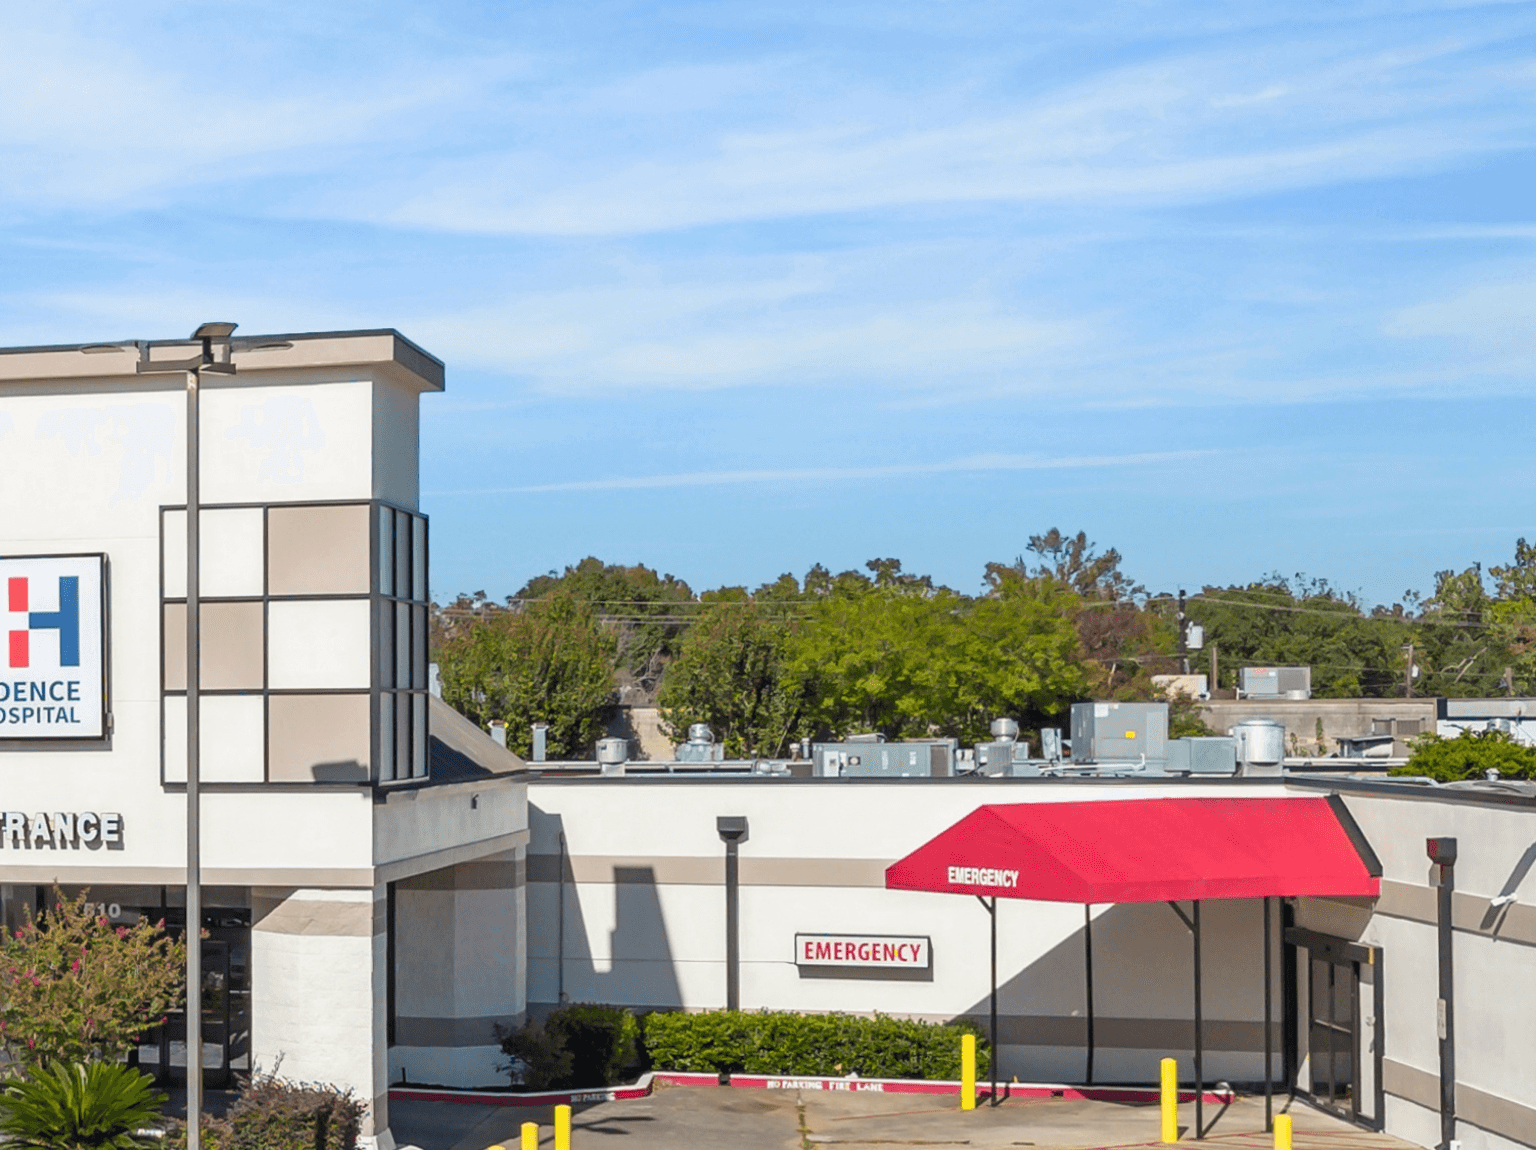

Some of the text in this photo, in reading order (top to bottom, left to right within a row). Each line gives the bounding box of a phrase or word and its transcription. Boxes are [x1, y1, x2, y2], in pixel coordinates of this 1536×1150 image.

[948, 866, 1020, 887] EMERGENCY
[804, 941, 921, 962] EMERGENCY
[767, 1080, 884, 1092] NO PARKING FIRE LANE
